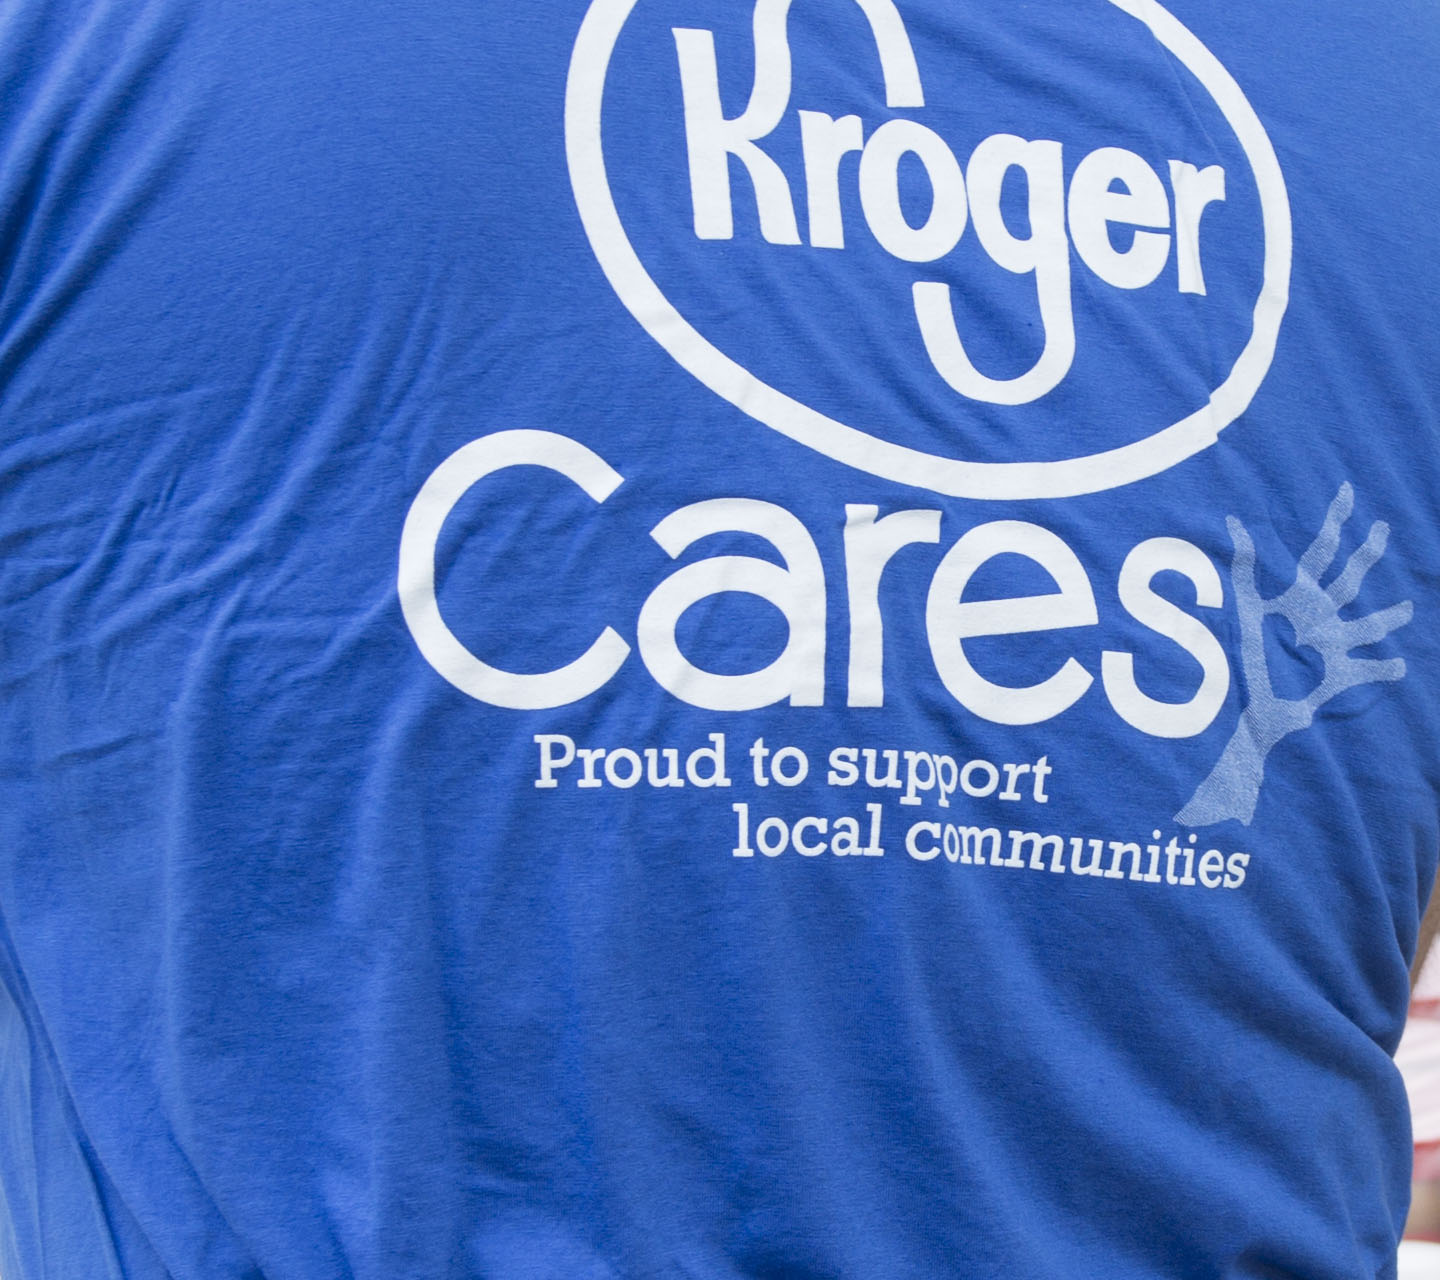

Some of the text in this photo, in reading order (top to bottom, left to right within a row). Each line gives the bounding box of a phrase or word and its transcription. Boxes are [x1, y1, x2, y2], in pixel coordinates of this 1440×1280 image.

[397, 429, 1230, 738] Cares
[534, 734, 1052, 807] Proud to support
[733, 802, 1250, 891] local communities
